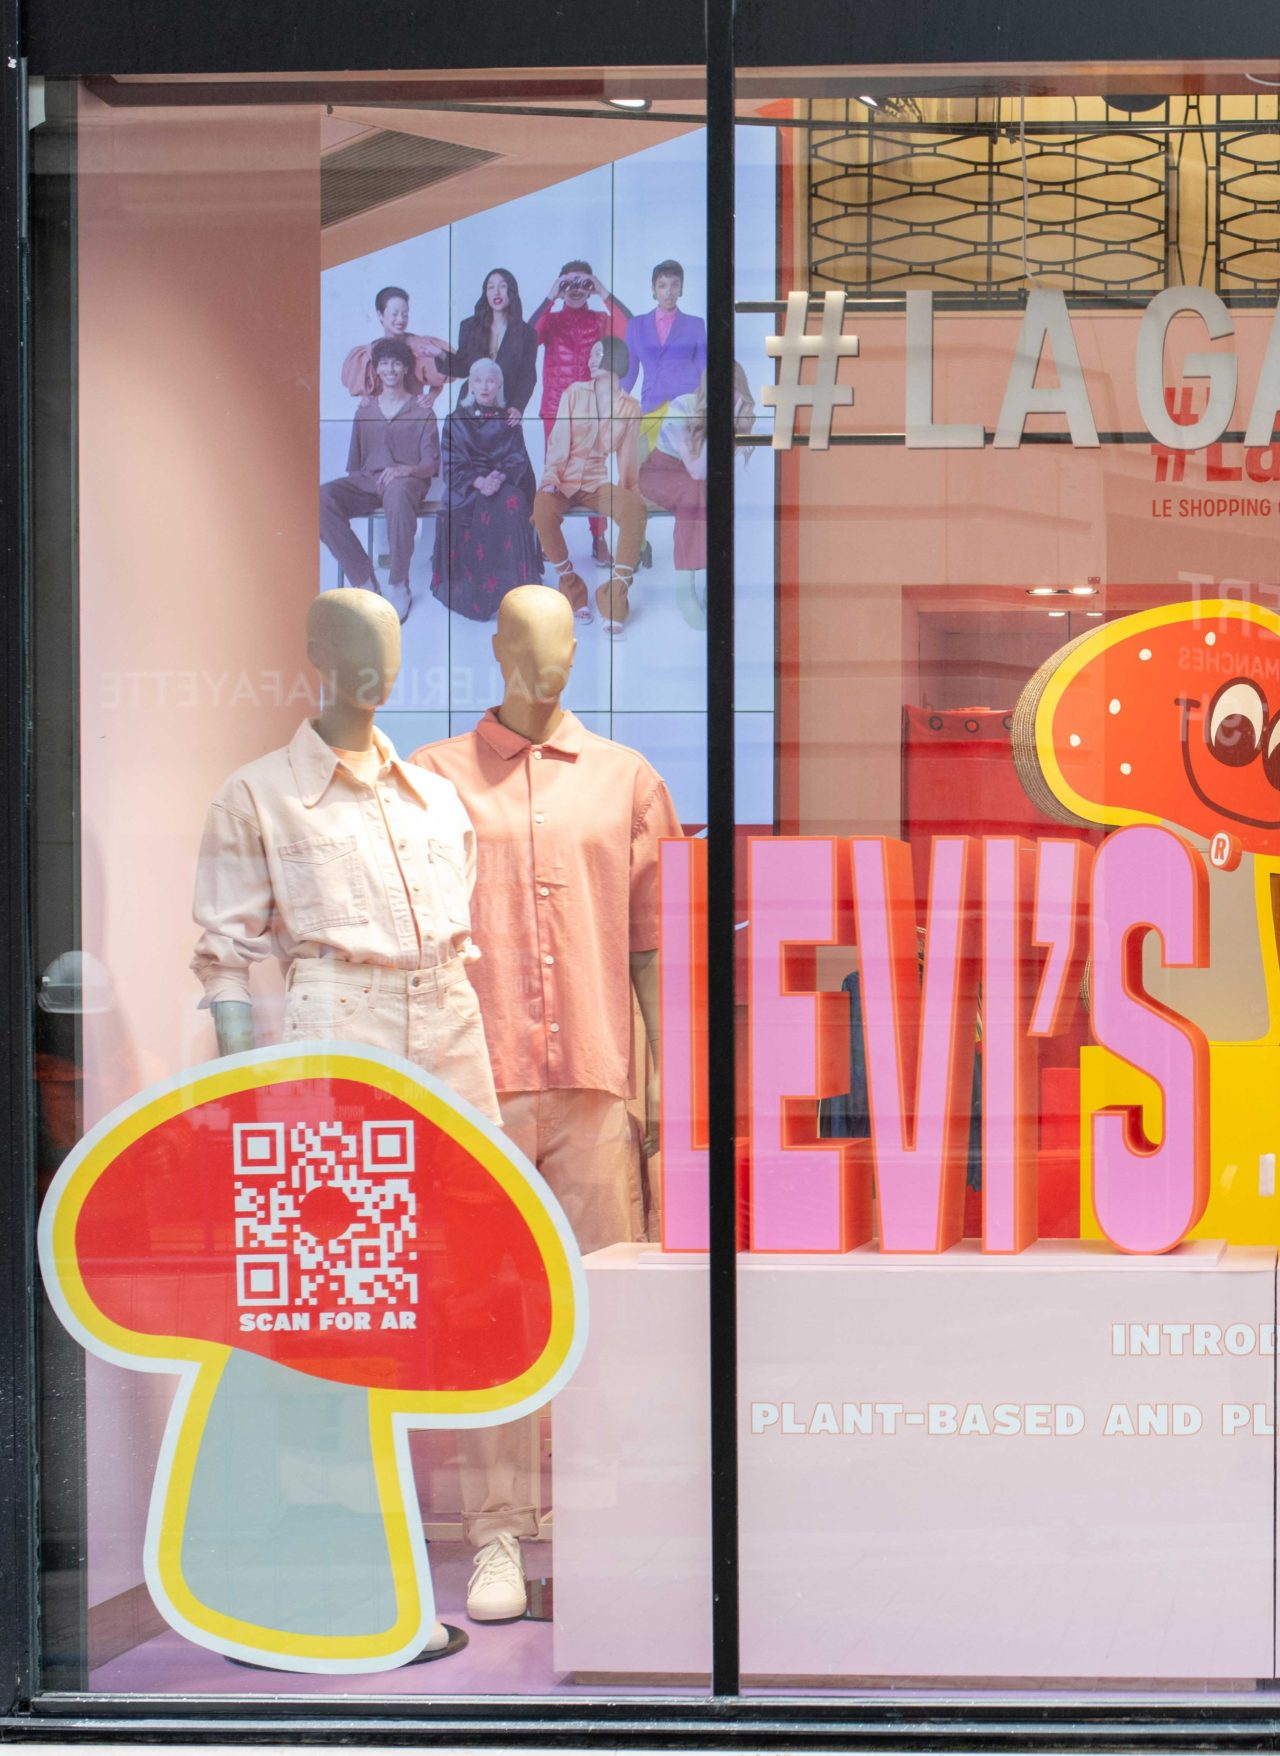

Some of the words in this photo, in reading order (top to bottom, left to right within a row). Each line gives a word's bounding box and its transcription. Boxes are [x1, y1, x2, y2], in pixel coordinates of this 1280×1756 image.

[762, 290, 859, 450] #
[905, 286, 1100, 449] LA
[1152, 499, 1172, 518] LE
[1179, 497, 1272, 518] SHOPPING
[658, 822, 1210, 1256] LEVI'S
[239, 1312, 310, 1331] SCAN
[319, 1311, 371, 1330] FOR
[380, 1311, 417, 1330] AR
[751, 1401, 1086, 1437] PLANT-BASED
[1102, 1402, 1203, 1437] AND
